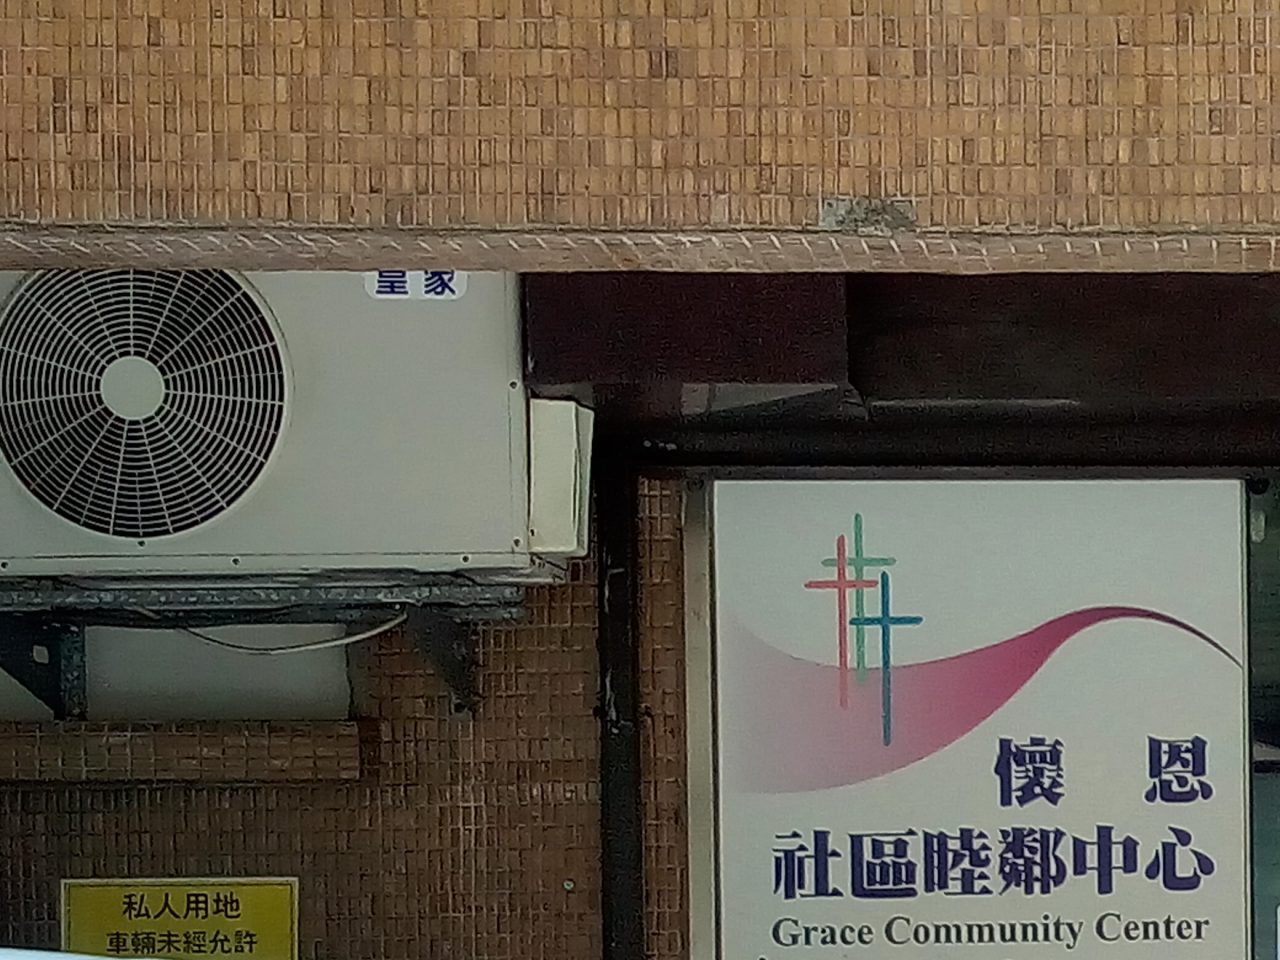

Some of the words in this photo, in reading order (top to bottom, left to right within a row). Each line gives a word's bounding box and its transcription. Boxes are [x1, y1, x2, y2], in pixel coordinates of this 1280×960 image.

[994, 734, 1214, 807] 懷恩
[772, 825, 1215, 900] 社區睦鄰中心
[122, 892, 242, 920] 私人用地
[105, 930, 258, 955] 車輛未經允許
[771, 917, 875, 948] Grace
[884, 914, 1084, 951] Community
[1095, 911, 1211, 943] Center
